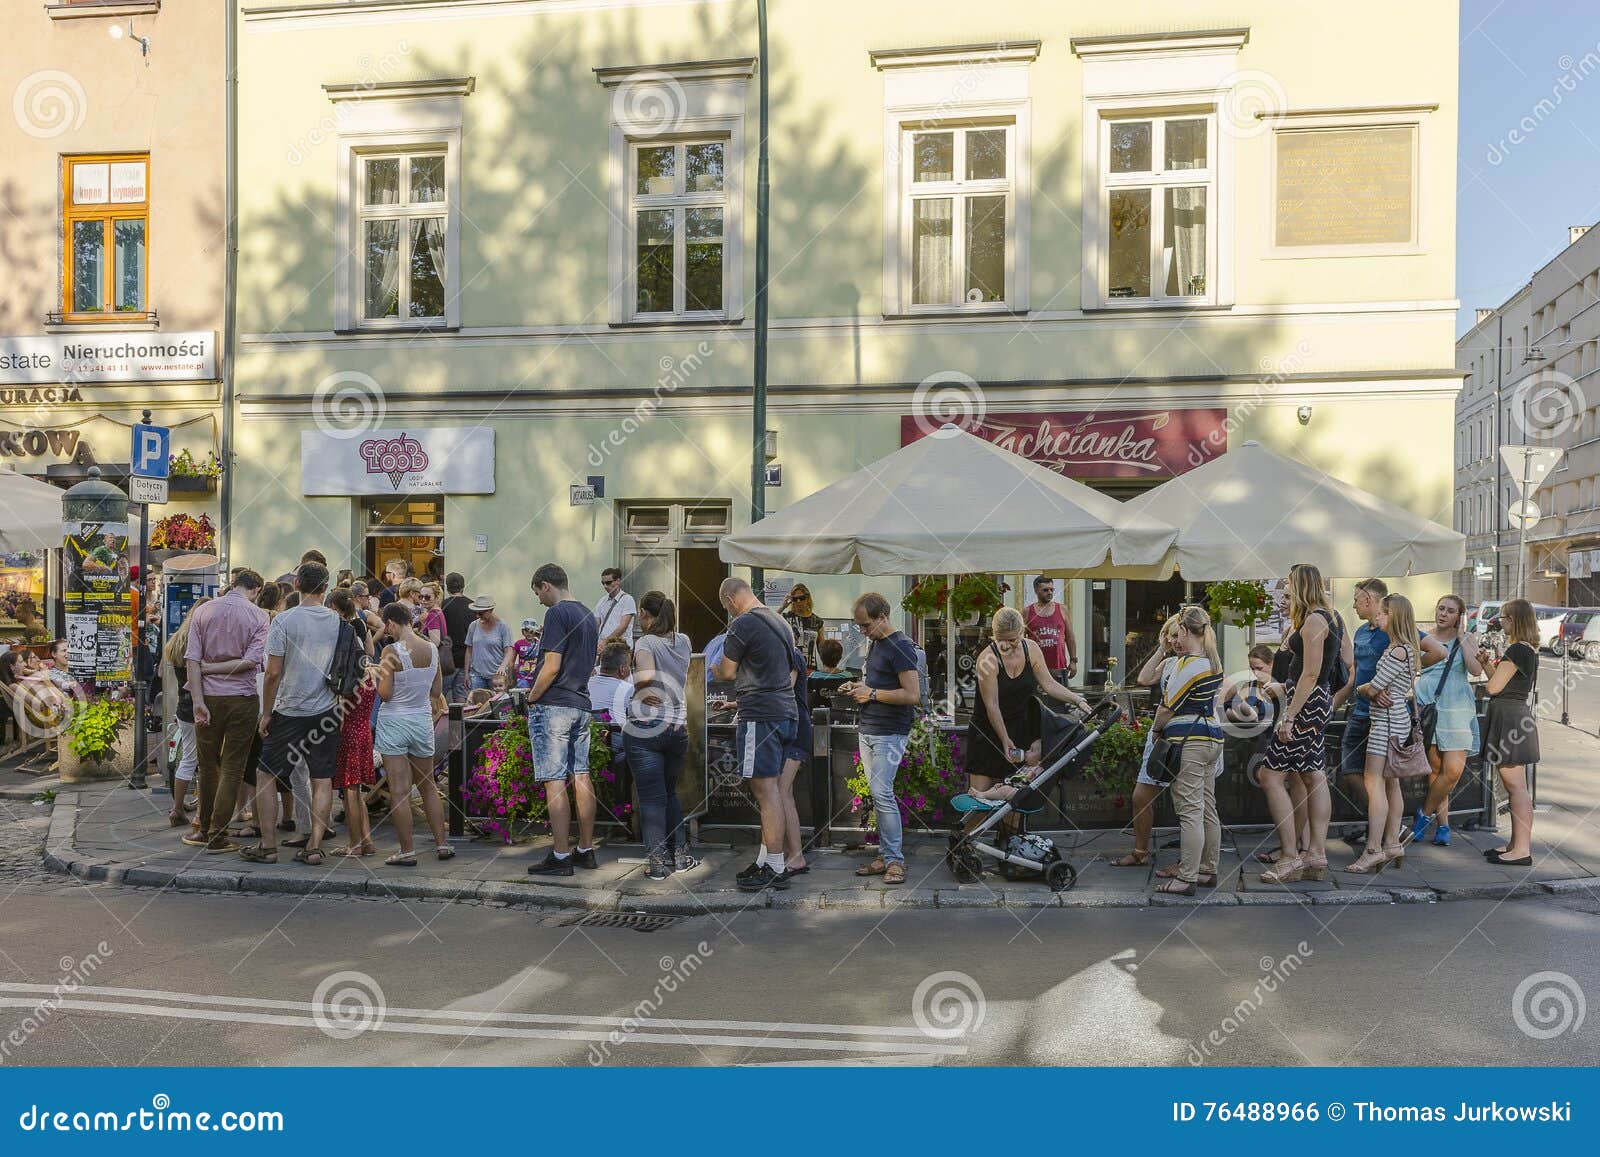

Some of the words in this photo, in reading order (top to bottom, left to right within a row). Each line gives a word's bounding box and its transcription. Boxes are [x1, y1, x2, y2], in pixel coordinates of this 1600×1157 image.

[63, 340, 205, 360] Nieruchomości
[141, 430, 162, 470] P
[136, 480, 163, 492] Dotyczy
